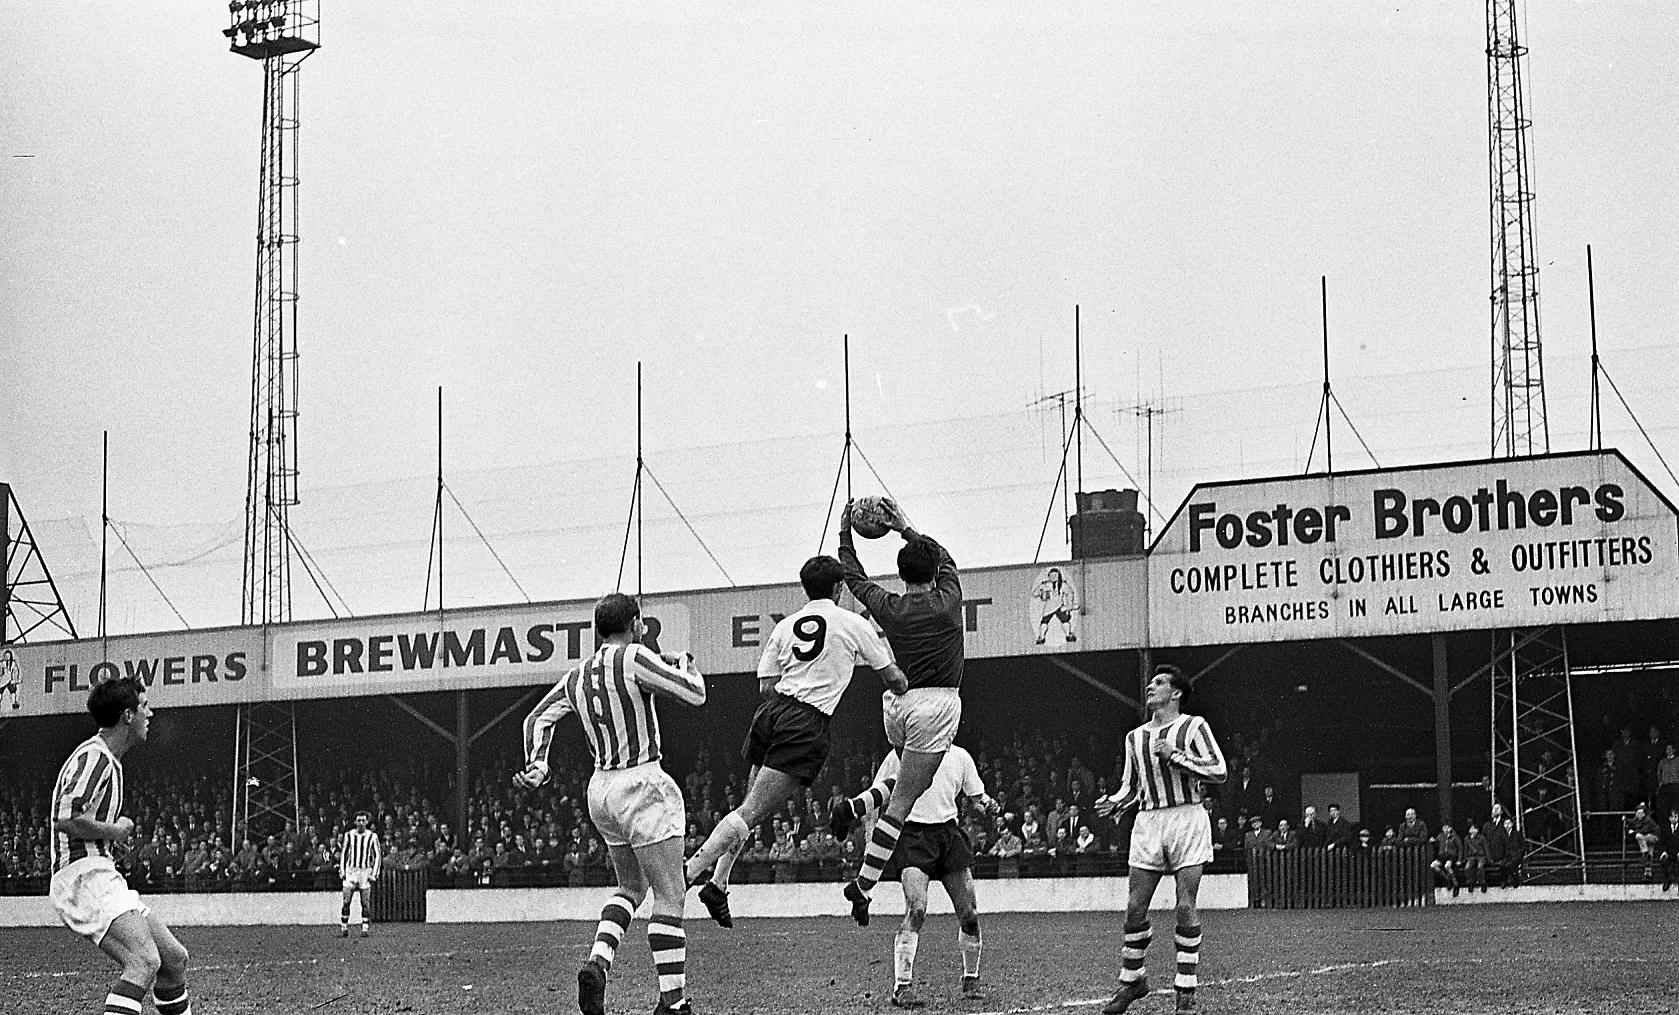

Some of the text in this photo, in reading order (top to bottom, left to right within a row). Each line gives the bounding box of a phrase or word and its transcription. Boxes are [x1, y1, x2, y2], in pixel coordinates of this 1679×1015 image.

[1188, 479, 1625, 553] Foster Brothers
[1170, 536, 1653, 594] COMPLETE CLOTHIERS & OUTFITTERS
[1225, 584, 1598, 625] BRANCHES IN ALL LARGE TOWNS
[296, 617, 662, 678] BREWMASTR
[791, 614, 828, 662] 9
[44, 651, 247, 694] FLOWERS
